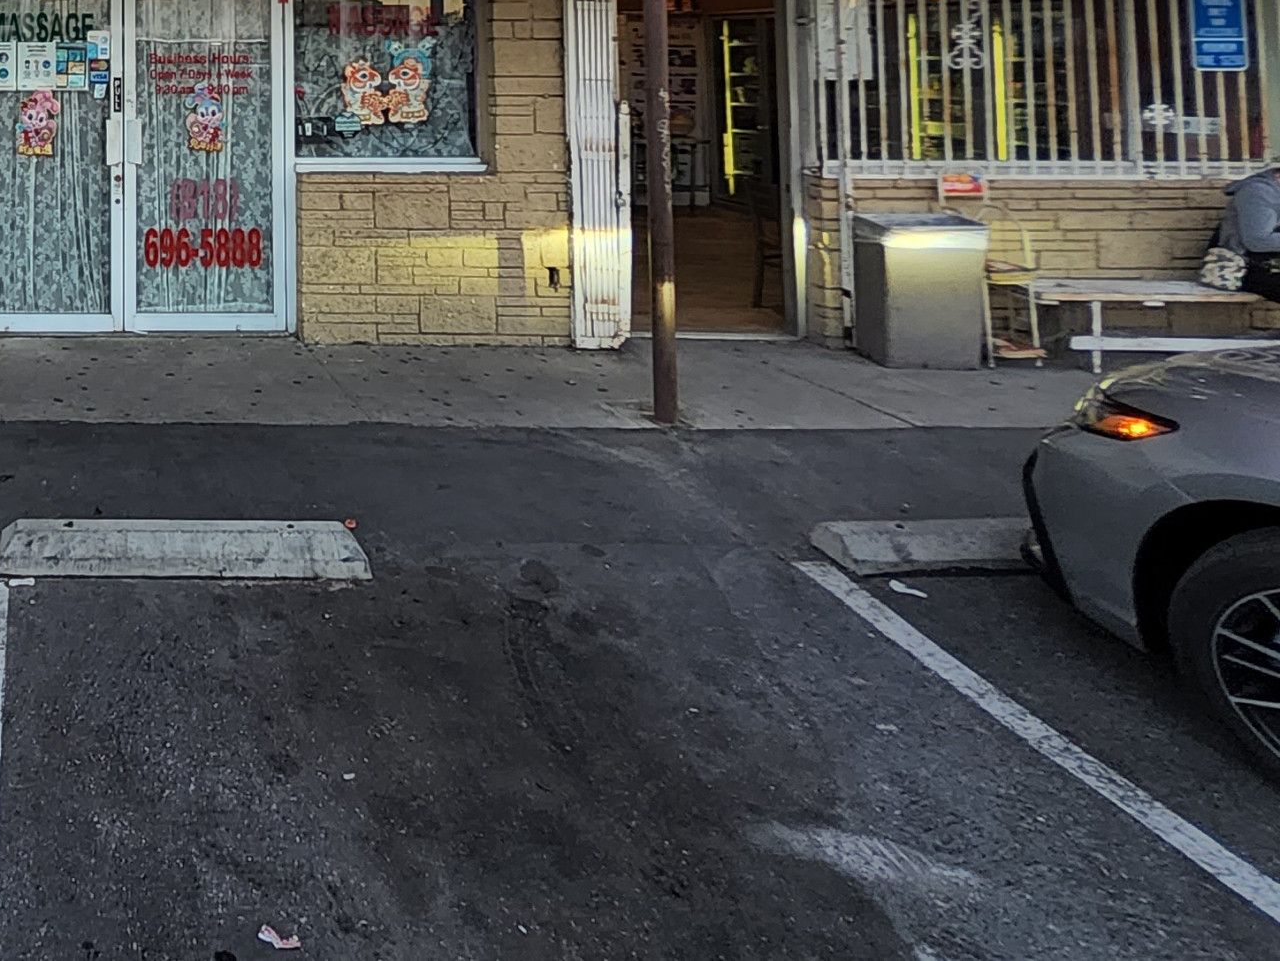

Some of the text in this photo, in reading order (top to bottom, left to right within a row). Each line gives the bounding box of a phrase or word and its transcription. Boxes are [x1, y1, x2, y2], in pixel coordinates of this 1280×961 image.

[149, 52, 207, 65] Business
[150, 69, 177, 81] Open
[188, 69, 212, 81] Days
[224, 69, 253, 80] Week
[144, 227, 262, 269] 696-5888
